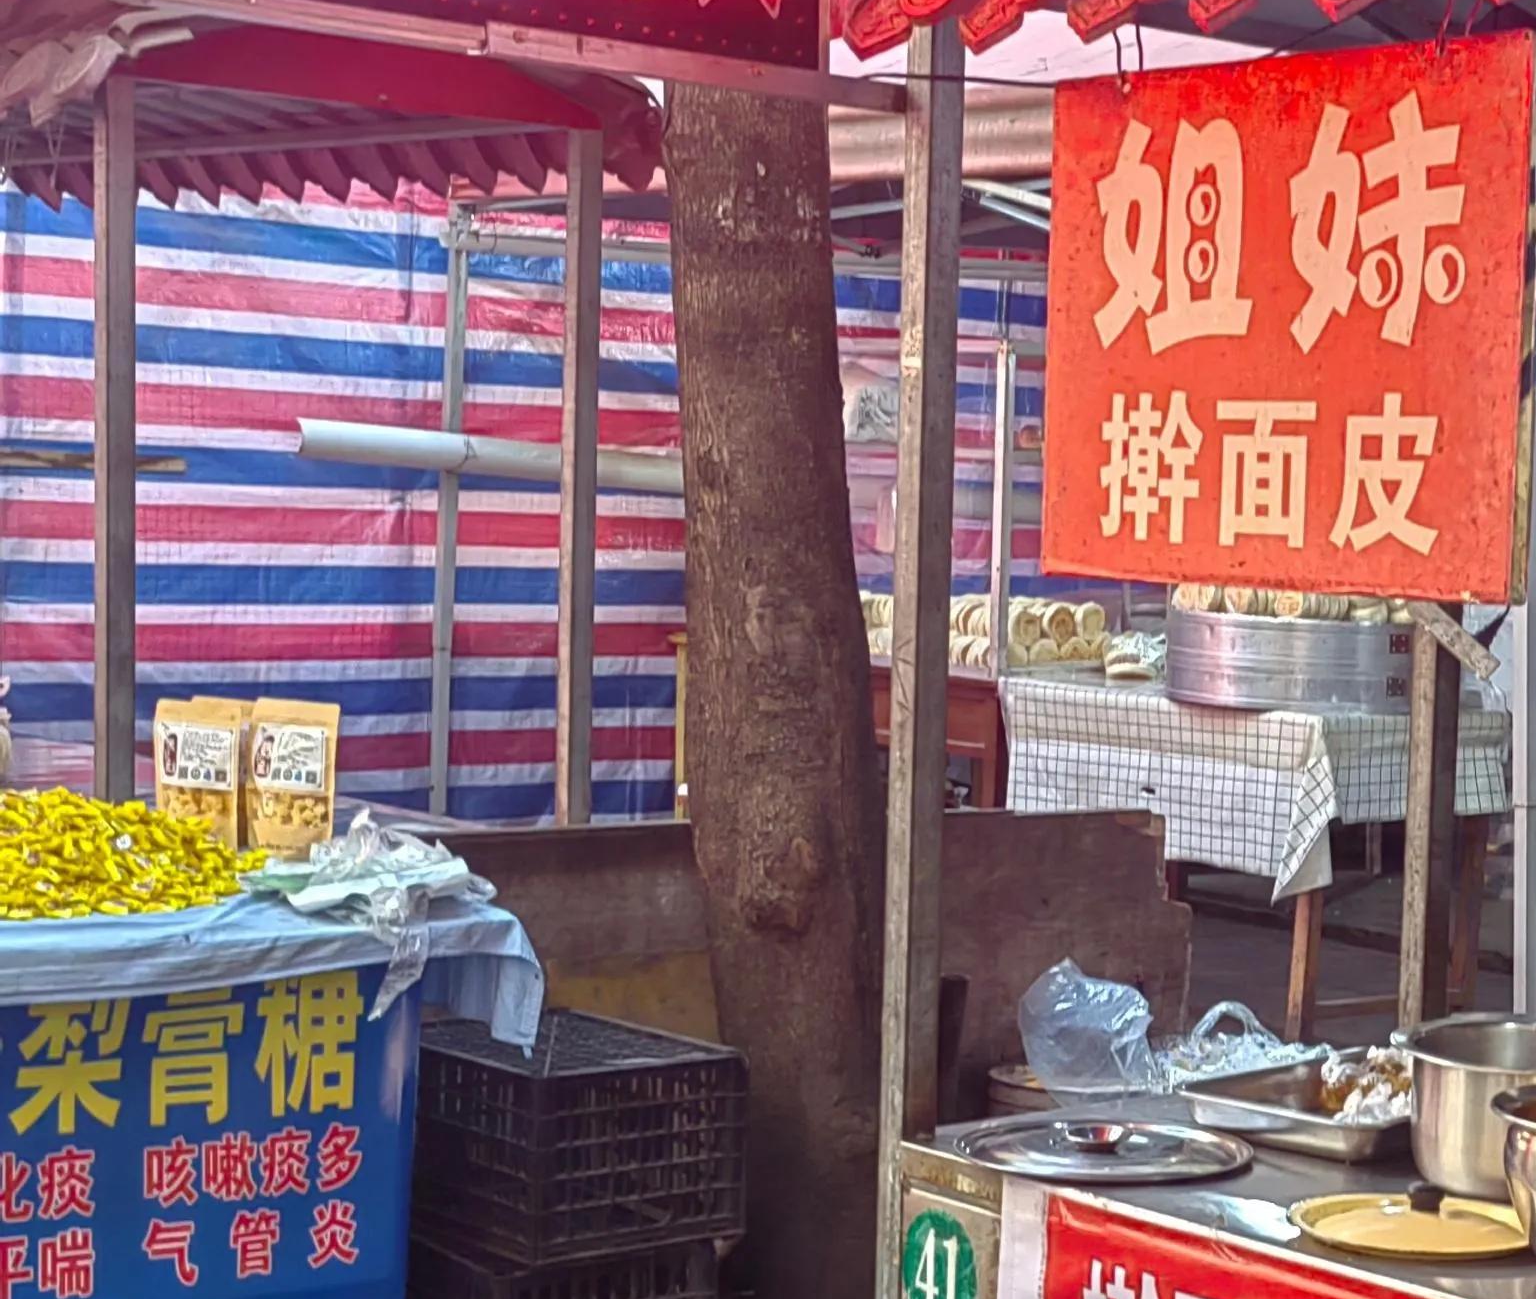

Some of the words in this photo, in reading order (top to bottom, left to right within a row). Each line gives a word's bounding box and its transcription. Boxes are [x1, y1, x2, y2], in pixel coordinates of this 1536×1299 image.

[1095, 89, 1466, 356] 姐妹
[1099, 389, 1440, 556] 擀面皮
[143, 1122, 363, 1209] 咳嗽痰多
[141, 1199, 359, 1287] 气管炎
